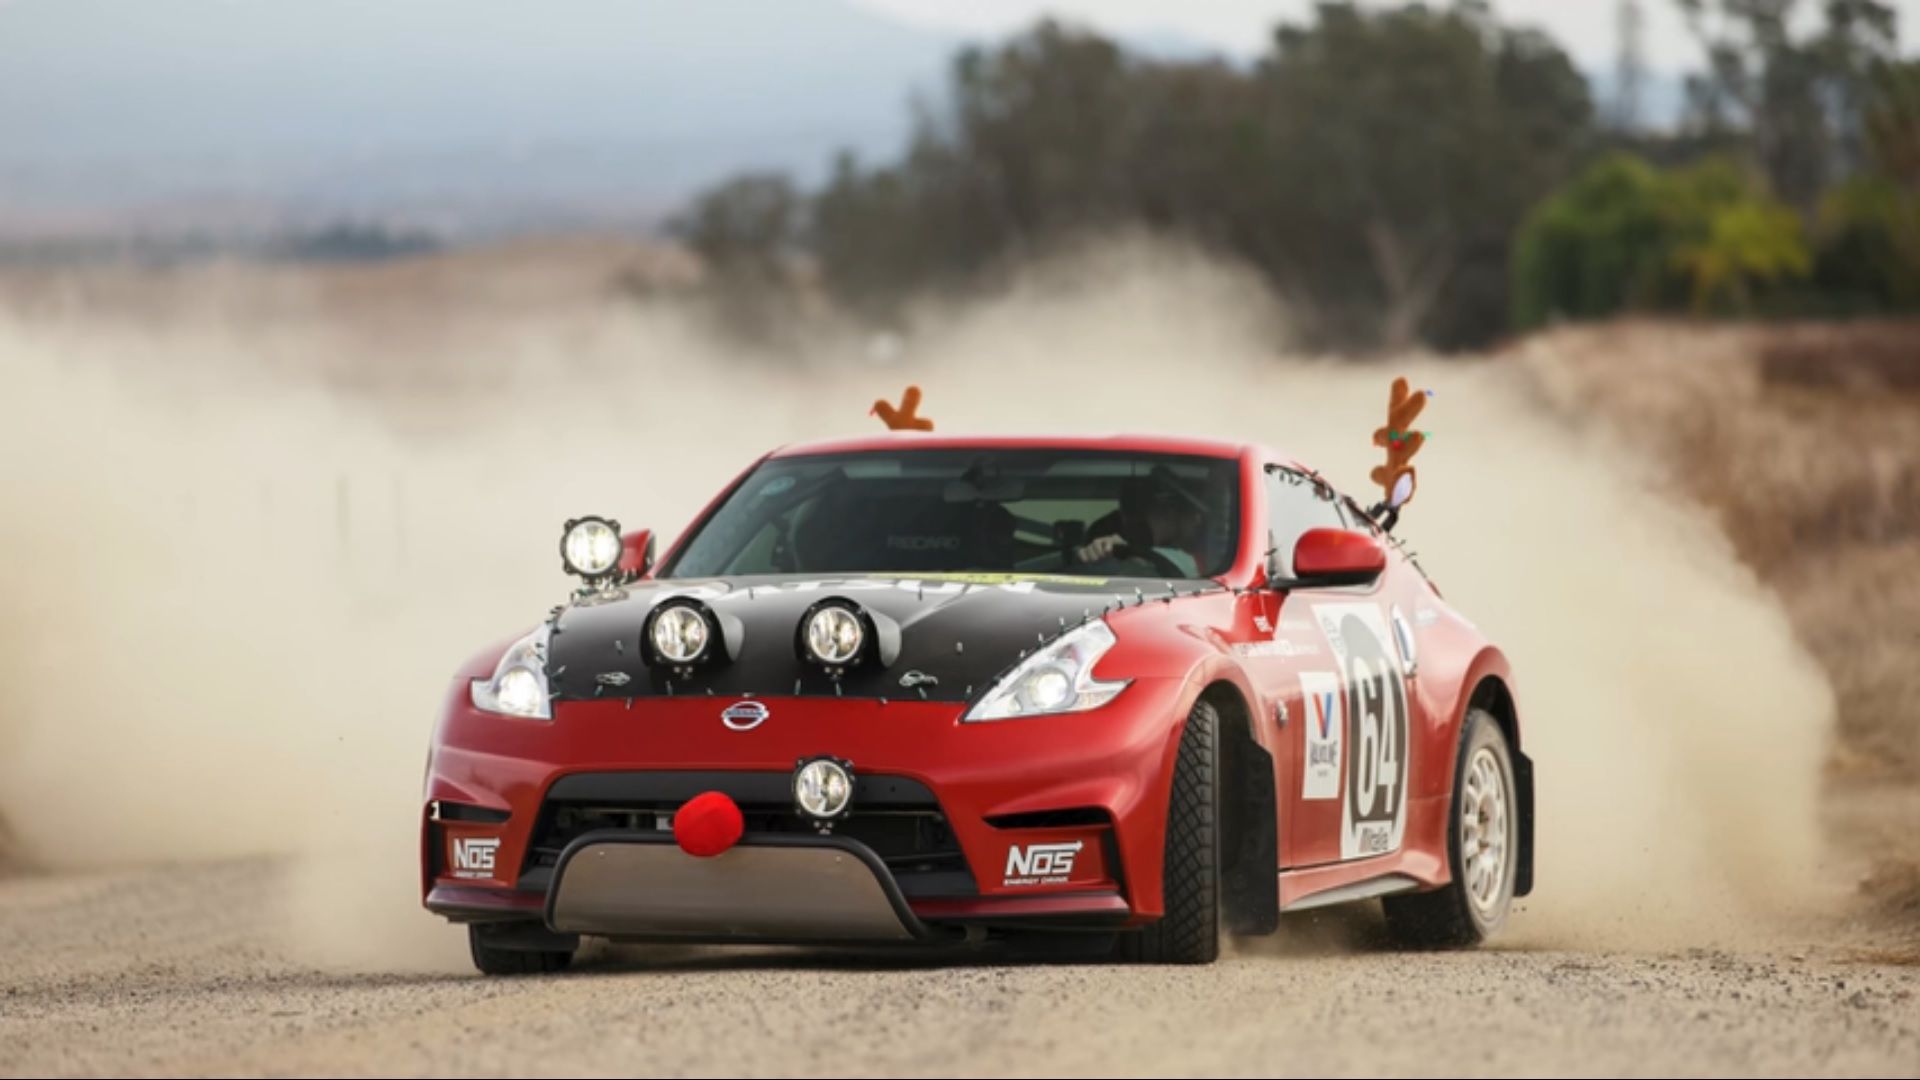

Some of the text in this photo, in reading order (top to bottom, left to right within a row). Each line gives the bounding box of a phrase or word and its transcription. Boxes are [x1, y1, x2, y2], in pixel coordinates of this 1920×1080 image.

[1352, 656, 1397, 817] 64
[453, 837, 501, 869] NOS
[1005, 841, 1083, 876] NOS
